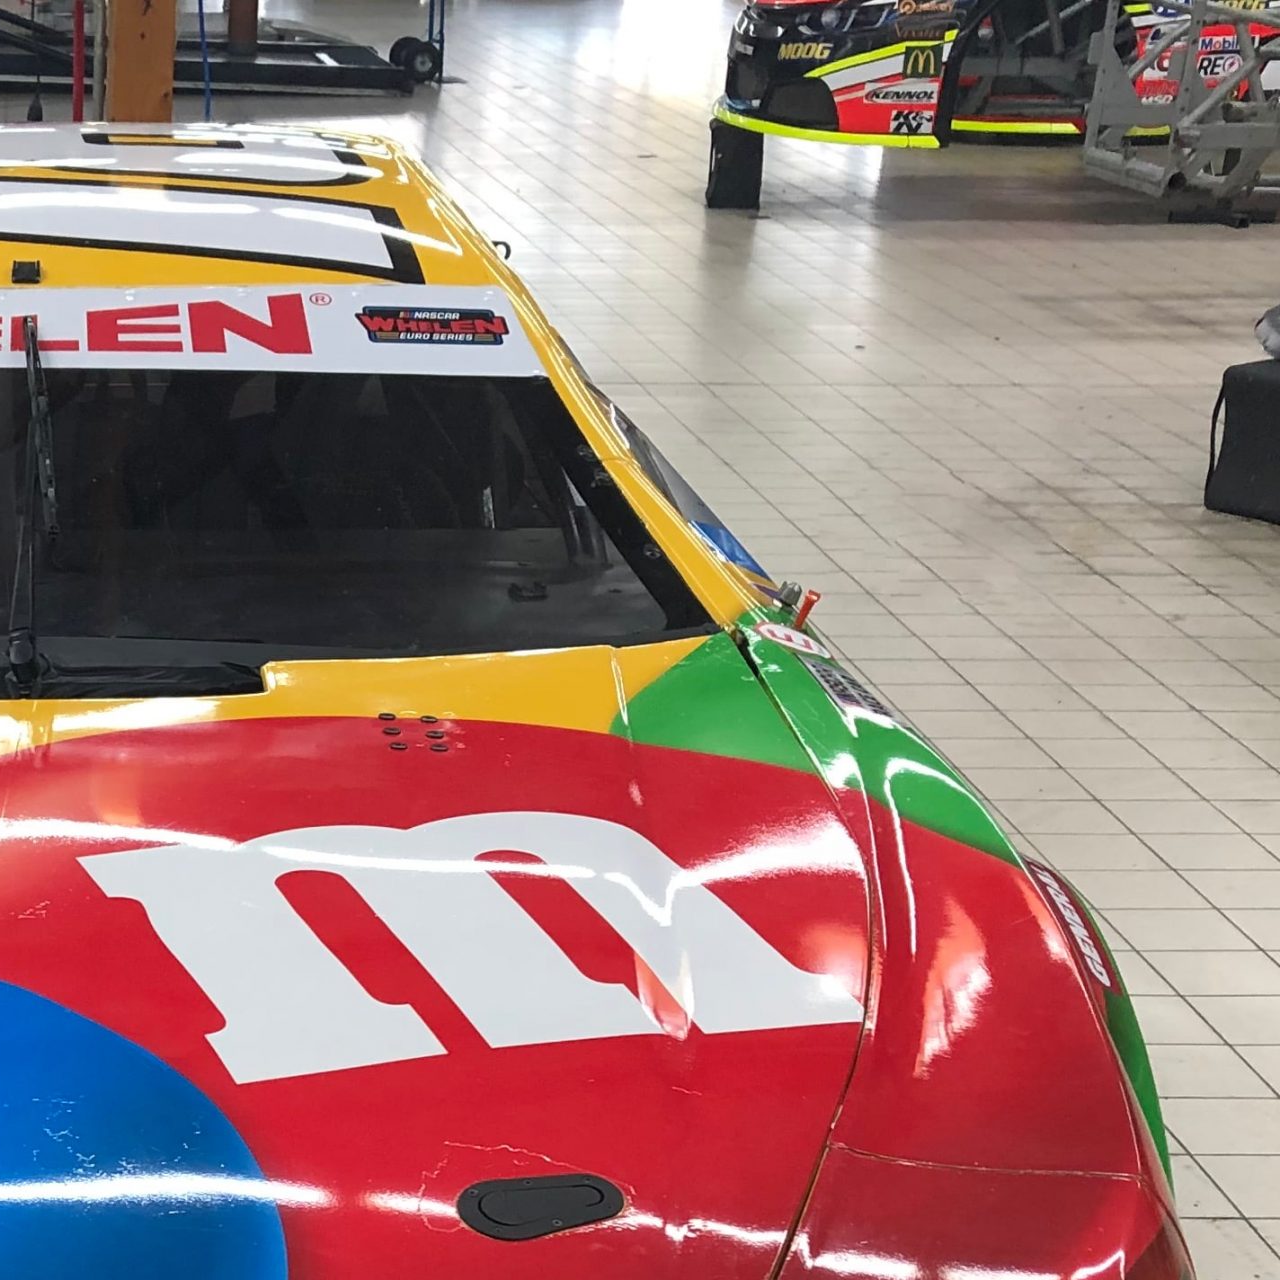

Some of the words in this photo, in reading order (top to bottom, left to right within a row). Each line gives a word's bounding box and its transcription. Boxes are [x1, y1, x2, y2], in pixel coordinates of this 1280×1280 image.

[777, 43, 833, 60] MOOG
[871, 90, 935, 100] KENNOL
[414, 311, 460, 320] NASCAR
[361, 315, 507, 335] WHELEN
[400, 332, 430, 341] EURO
[433, 332, 473, 342] SERIES
[76, 810, 865, 1085] m
